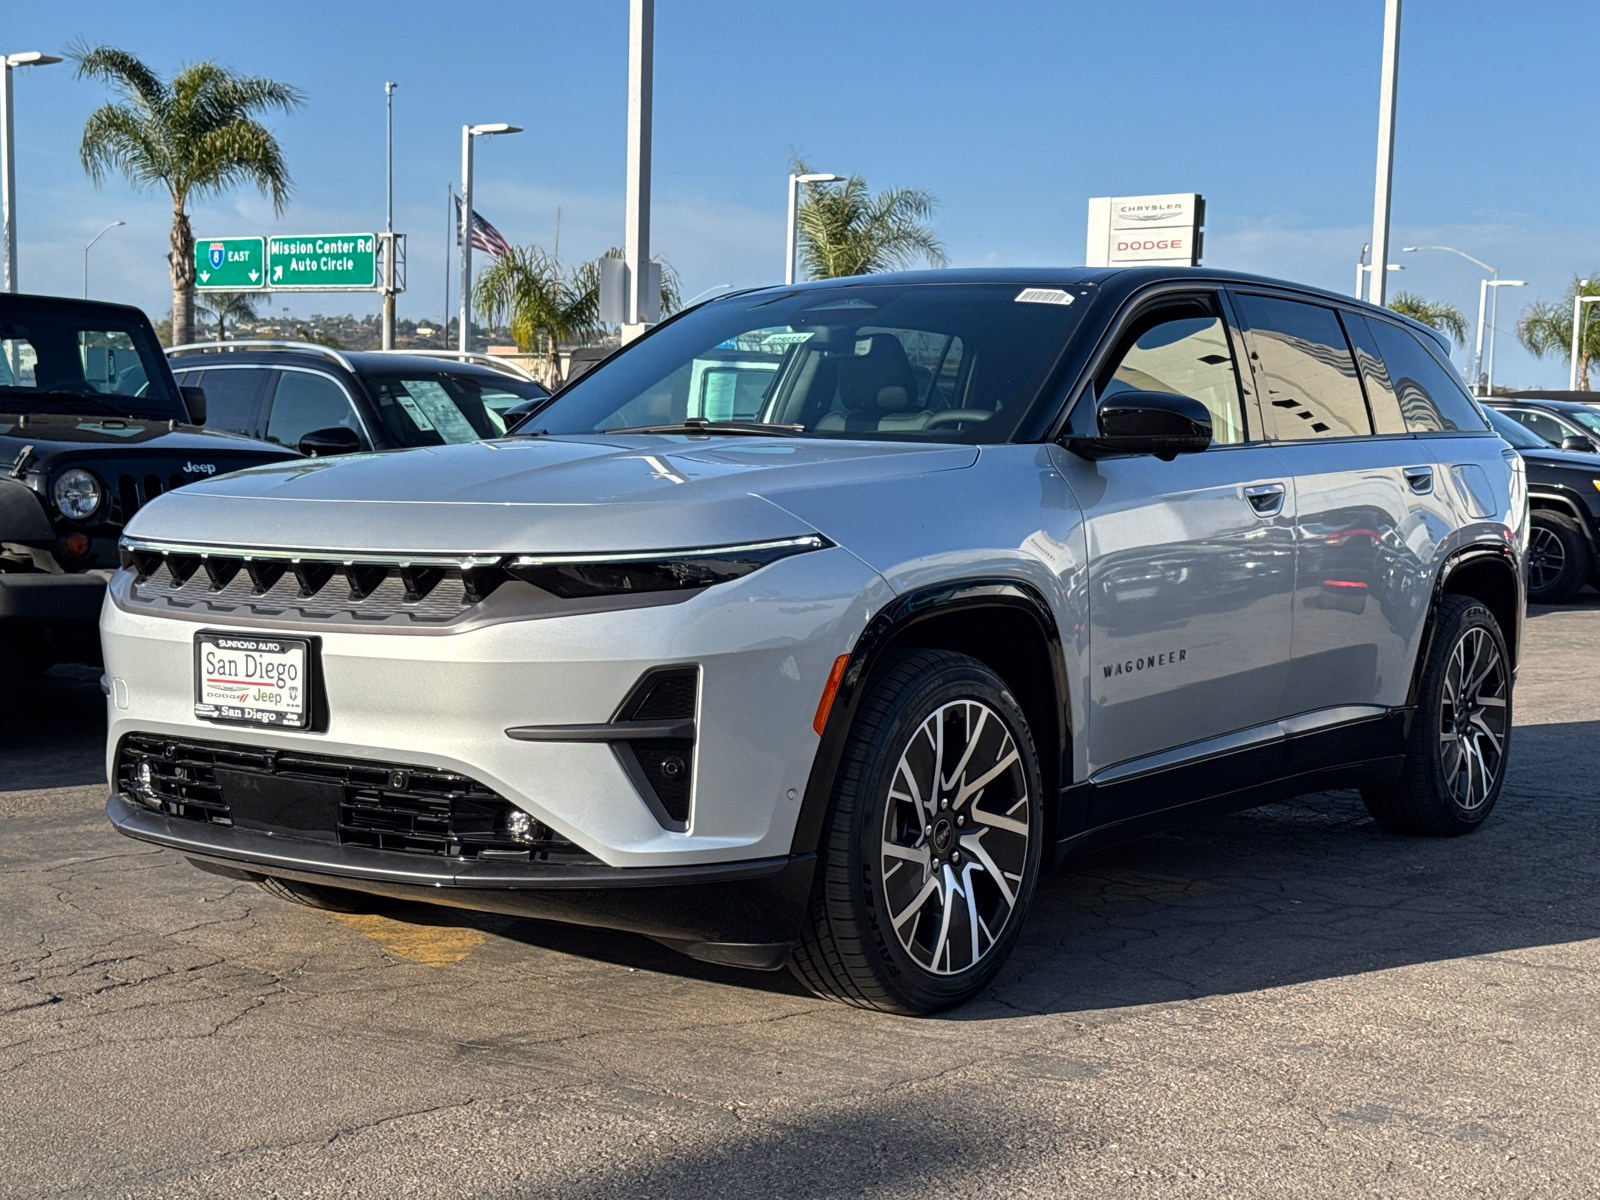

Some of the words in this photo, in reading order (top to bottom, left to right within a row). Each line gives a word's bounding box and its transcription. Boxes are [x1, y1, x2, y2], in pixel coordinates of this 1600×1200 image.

[1121, 203, 1182, 212] CHRYSLER
[271, 241, 314, 255] Mission
[316, 239, 355, 254] Center
[357, 239, 373, 253] Rd
[1117, 240, 1182, 251] DODGE
[213, 250, 220, 264] 8
[227, 250, 250, 262] EAST
[290, 257, 318, 271] Auto
[320, 256, 354, 271] Circle
[182, 460, 217, 475] Jeep
[218, 639, 257, 650] SUNROAD
[258, 643, 280, 652] AUTO
[206, 651, 239, 677] San
[244, 654, 298, 689] Diego
[1103, 649, 1187, 678] WAGONEER
[253, 688, 282, 706] Jeep
[221, 706, 242, 717] San
[245, 709, 277, 723] Diego
[862, 863, 902, 978] FALKEN
